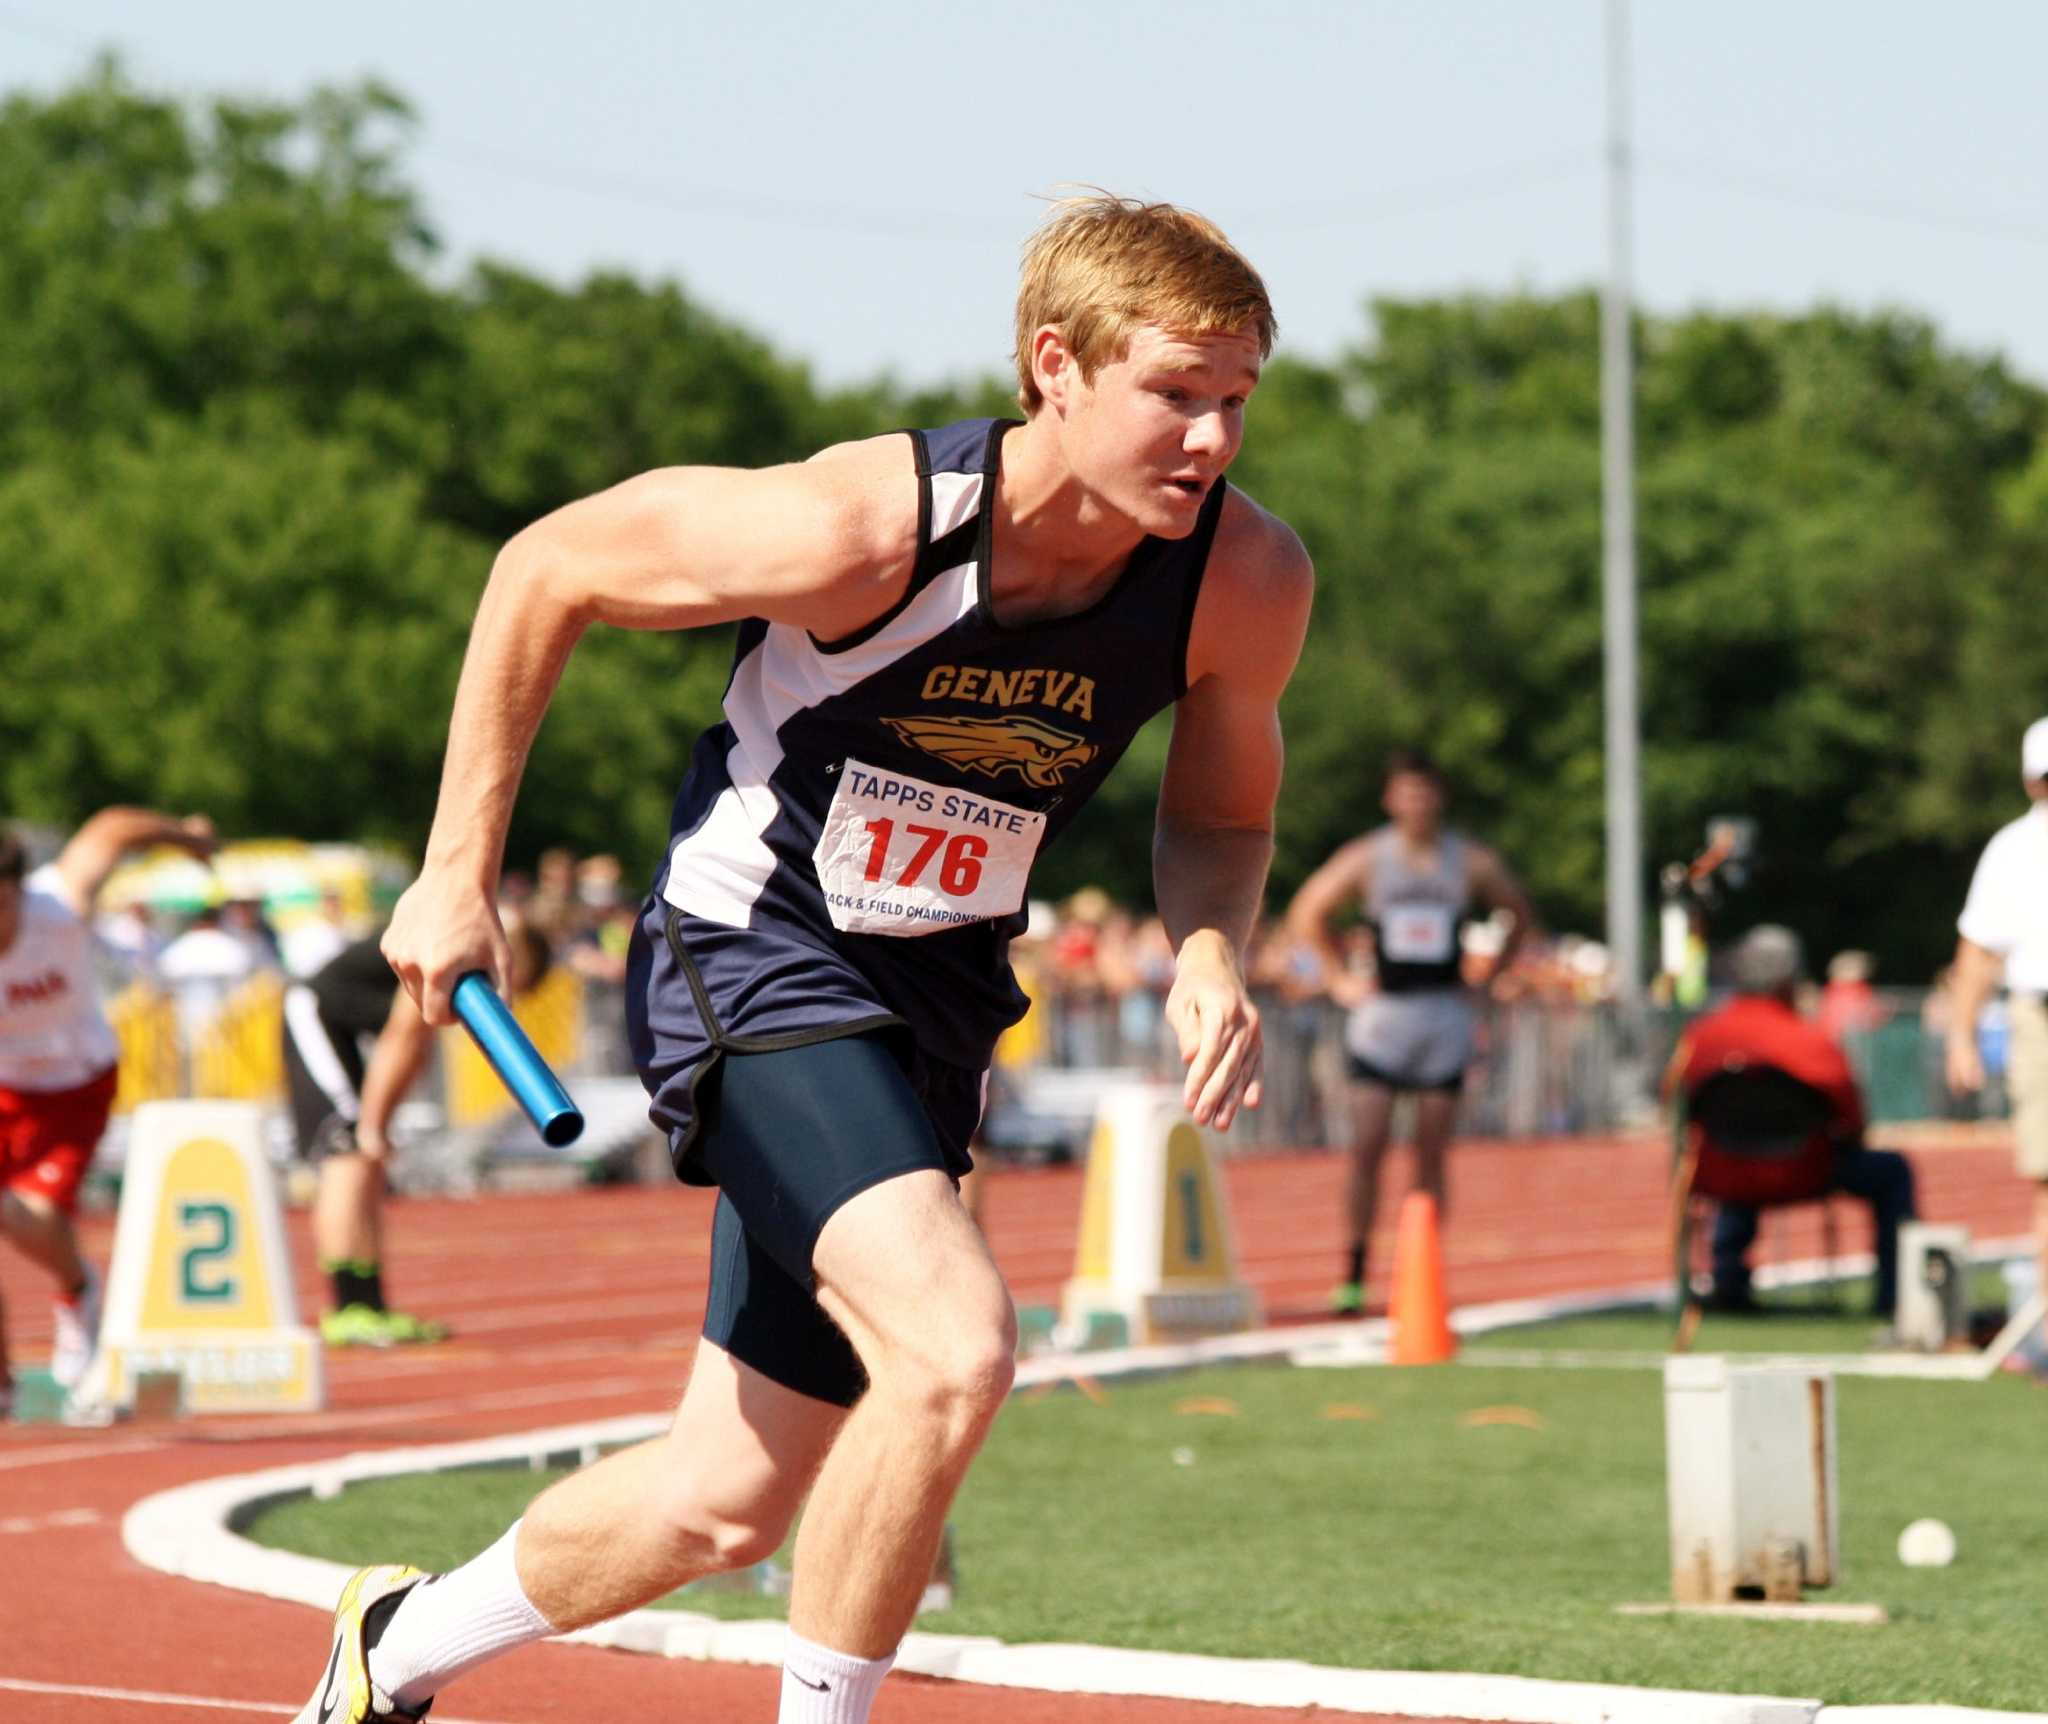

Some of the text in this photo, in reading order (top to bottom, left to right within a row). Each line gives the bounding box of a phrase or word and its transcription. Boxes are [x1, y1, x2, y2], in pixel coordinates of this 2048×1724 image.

[920, 665, 1096, 722] GENEVA
[850, 770, 1026, 834] TAPPS STATE
[864, 817, 988, 897] 176
[856, 897, 864, 910] &
[869, 899, 903, 915] FIELD
[179, 1204, 234, 1299] 2
